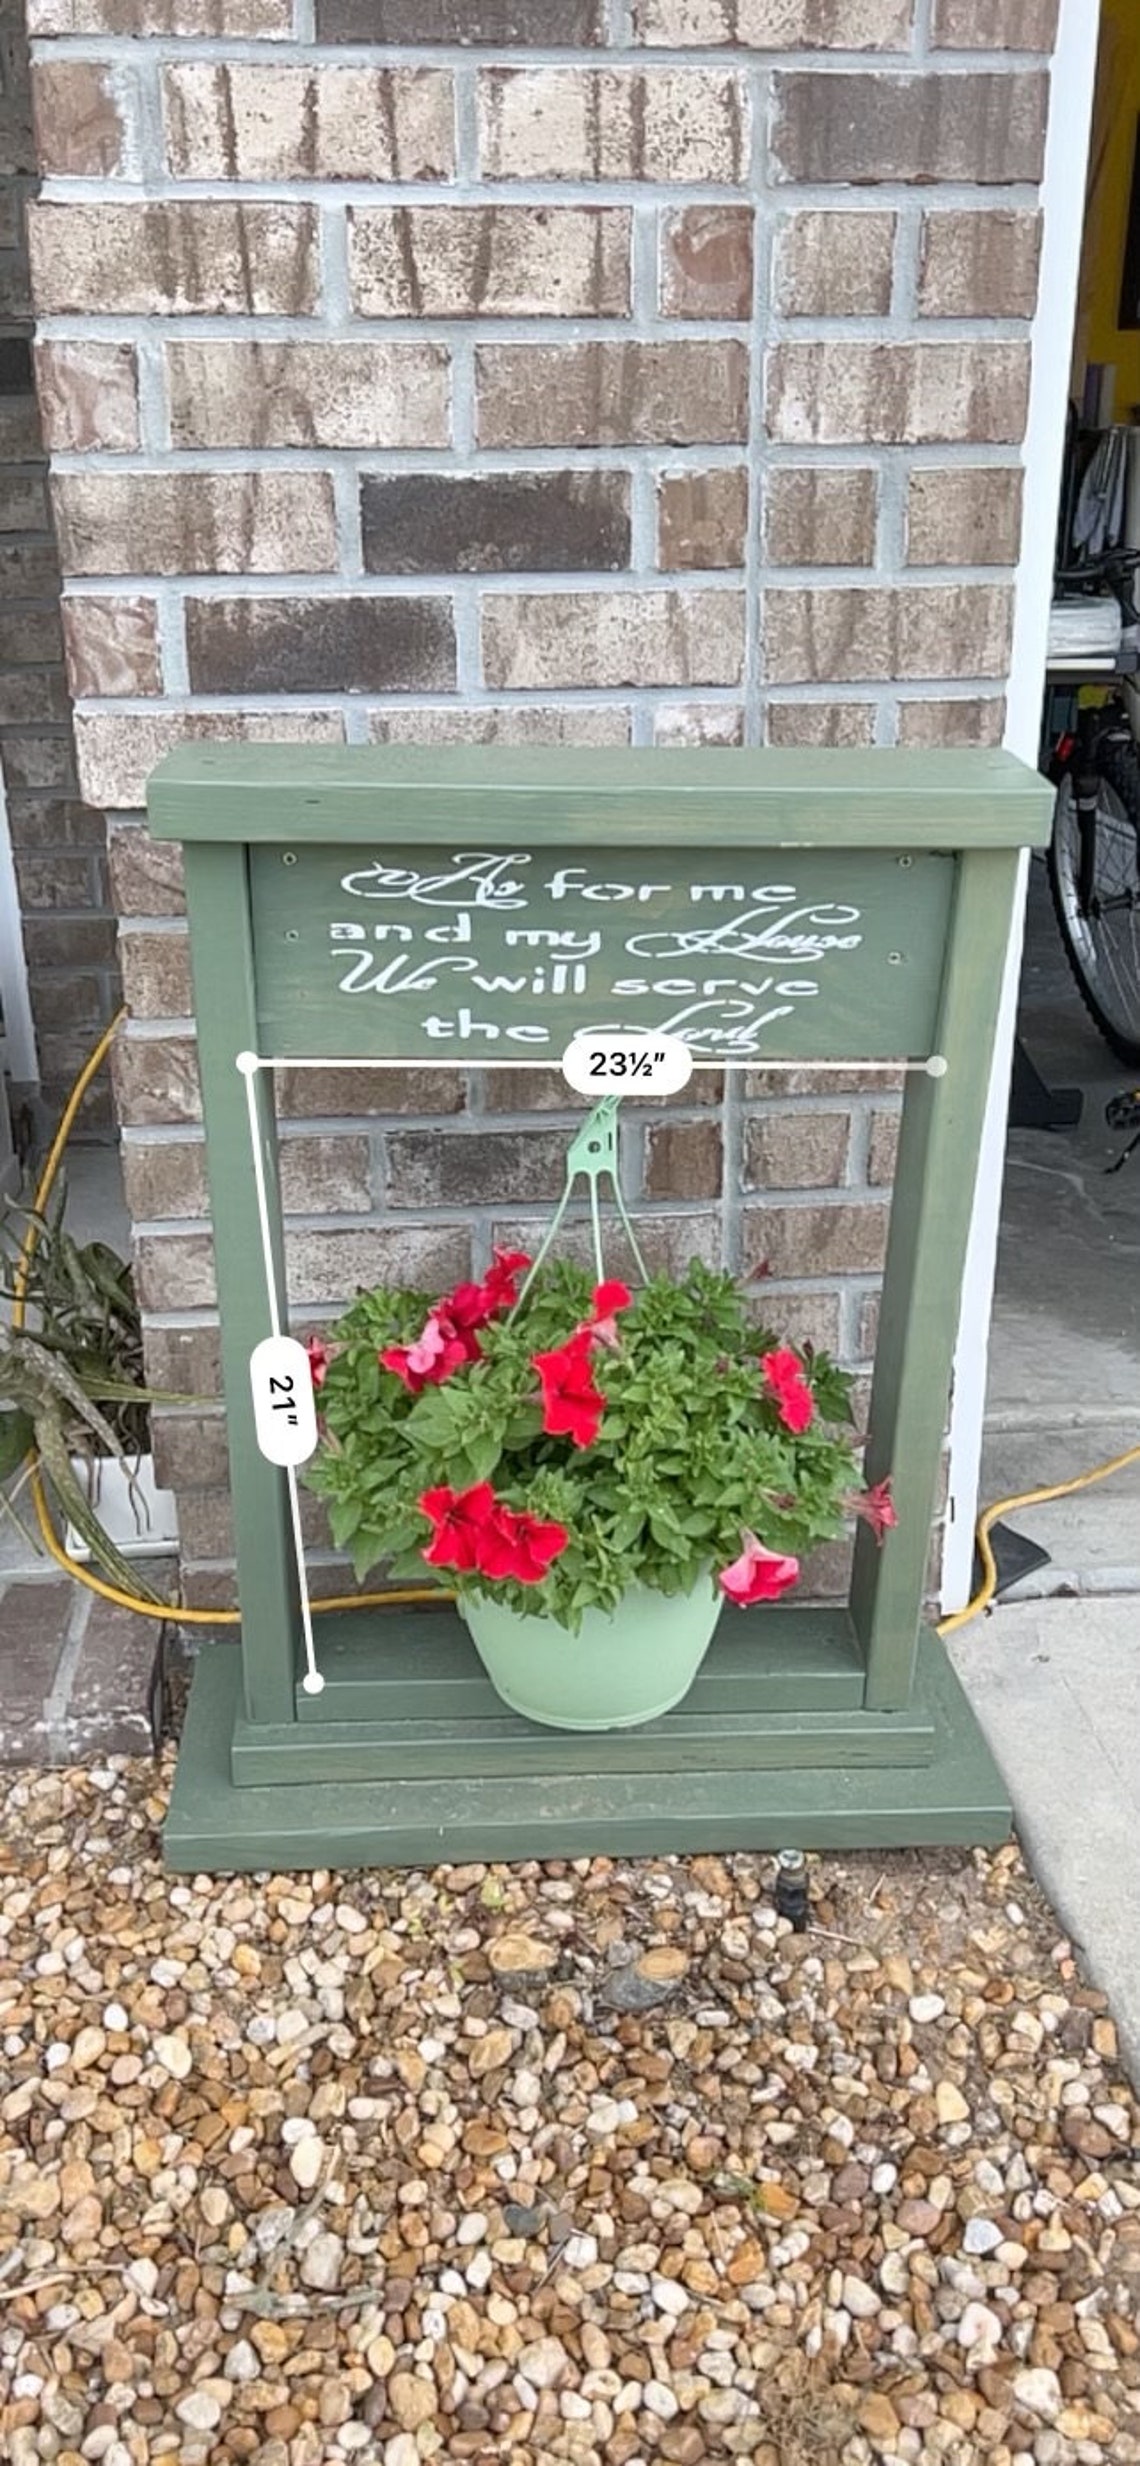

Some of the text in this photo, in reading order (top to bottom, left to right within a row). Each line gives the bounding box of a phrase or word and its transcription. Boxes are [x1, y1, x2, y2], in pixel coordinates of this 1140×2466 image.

[341, 853, 797, 910] As for me
[330, 903, 863, 964] and my House
[330, 949, 820, 997] We will serve
[420, 1008, 550, 1043] the
